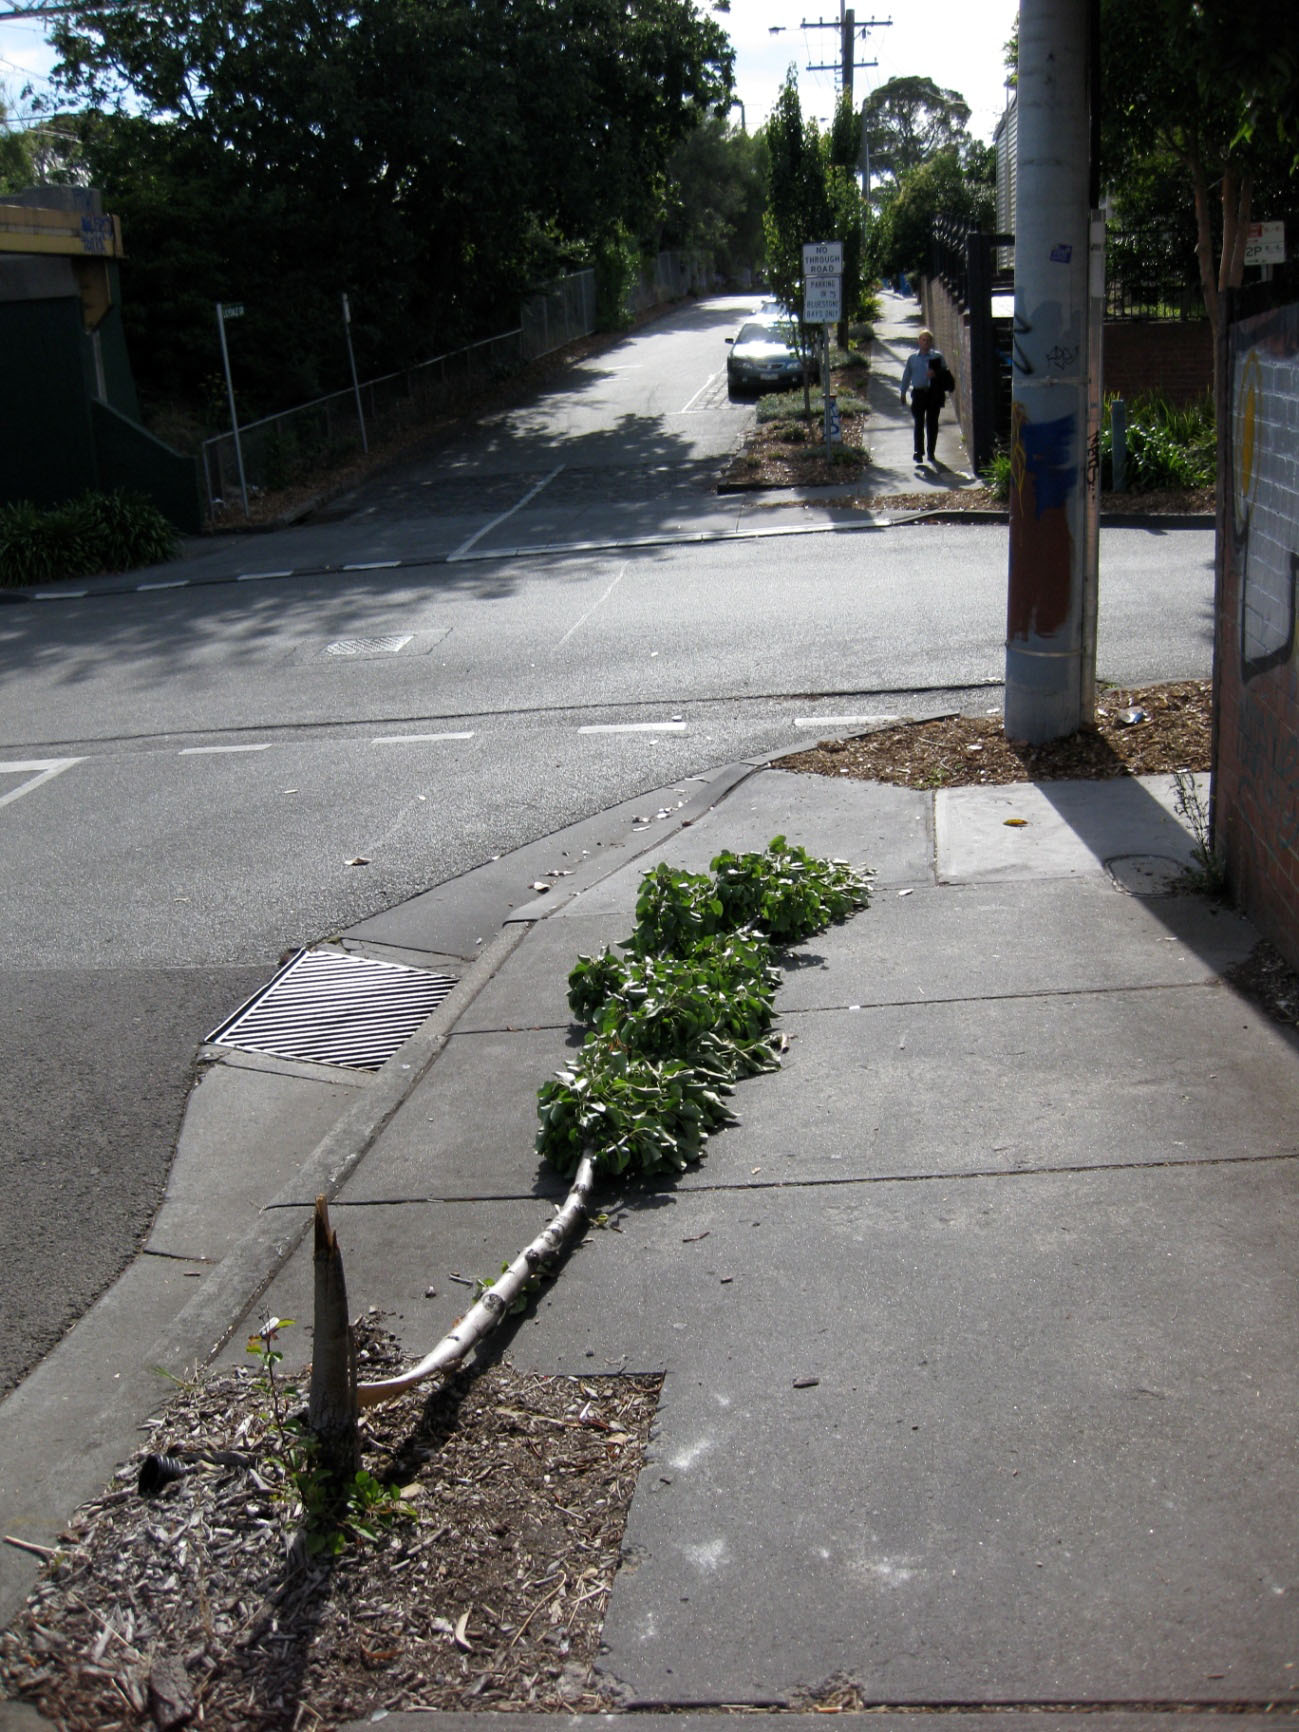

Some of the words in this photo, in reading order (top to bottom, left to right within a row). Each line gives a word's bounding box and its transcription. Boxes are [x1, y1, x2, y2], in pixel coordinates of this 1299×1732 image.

[1246, 246, 1262, 257] 2P
[805, 256, 840, 264] THROUGH
[811, 280, 836, 288] PARKING
